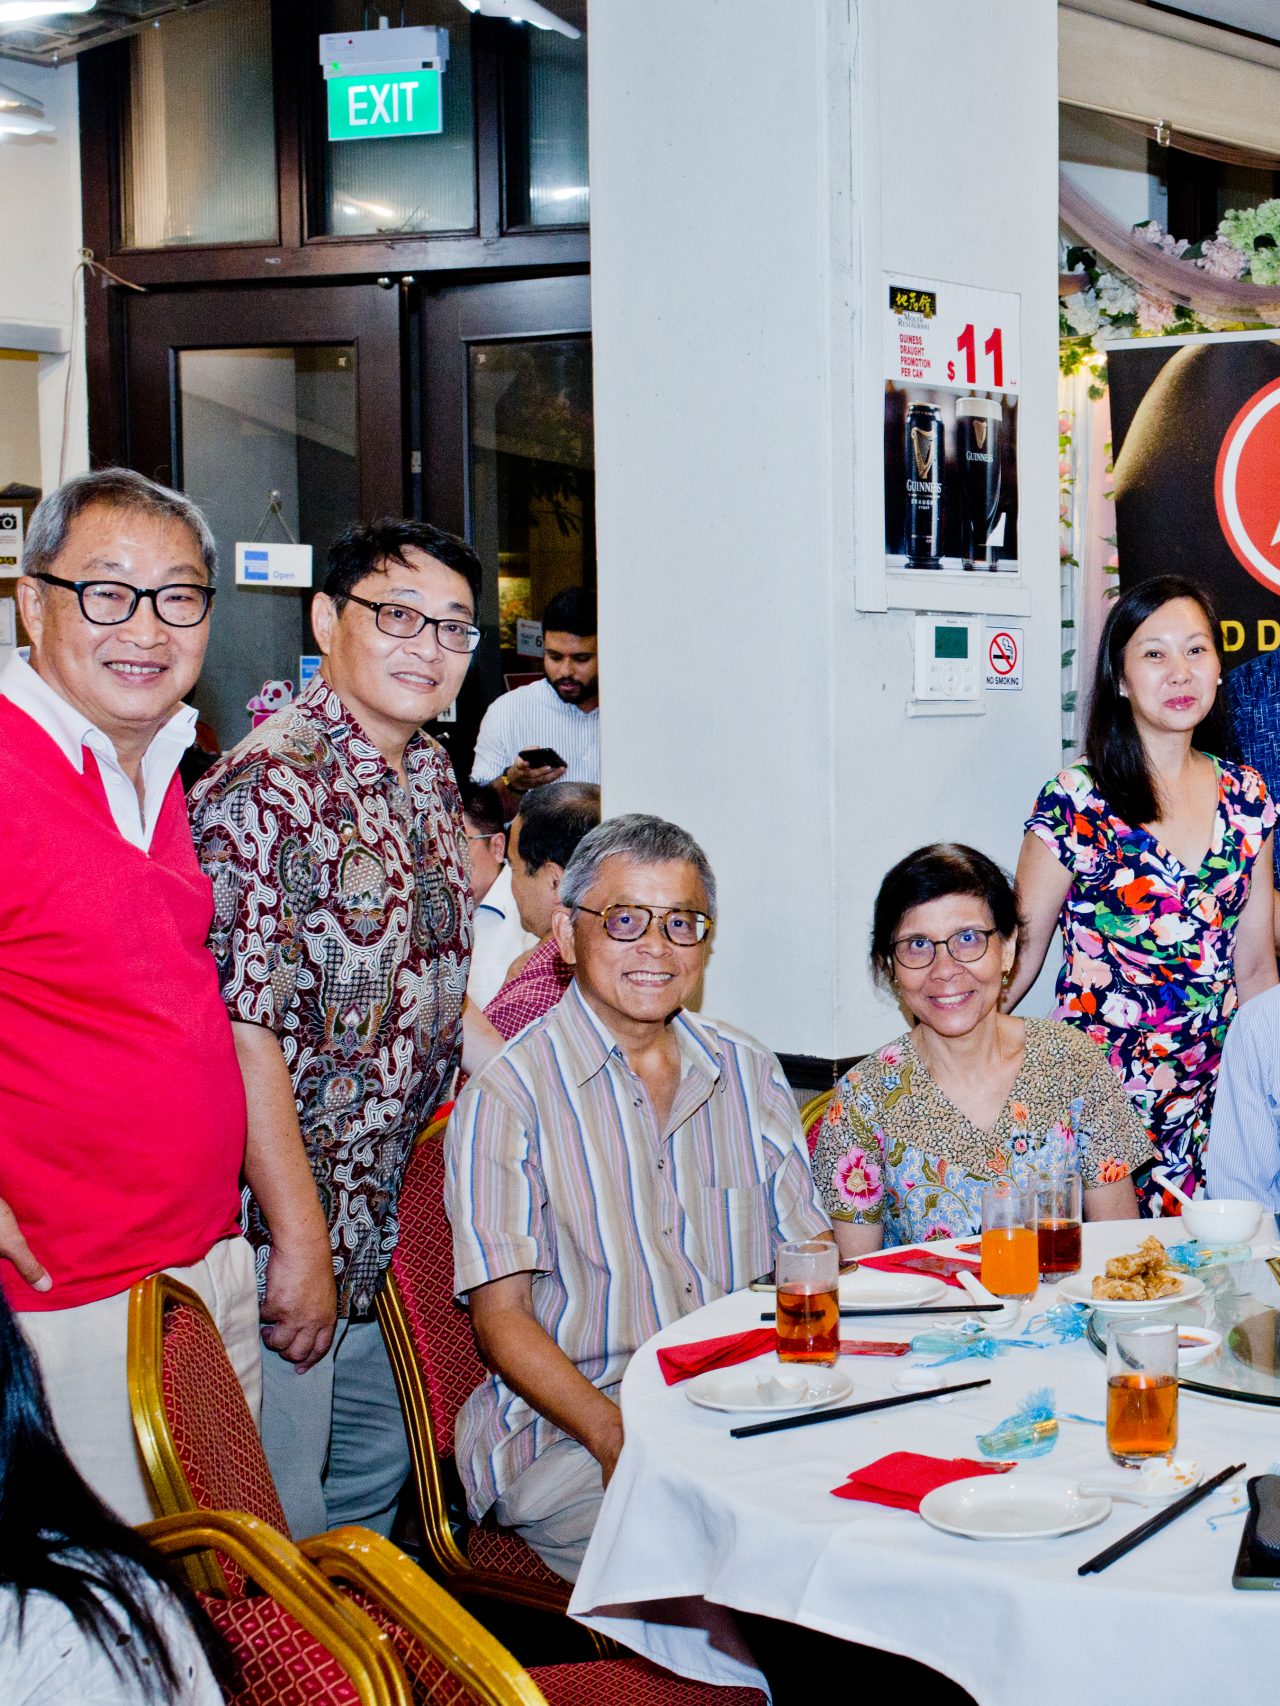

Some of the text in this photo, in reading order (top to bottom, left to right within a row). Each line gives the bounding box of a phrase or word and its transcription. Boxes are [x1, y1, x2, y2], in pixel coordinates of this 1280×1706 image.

[348, 81, 420, 126] EXIT
[900, 334, 922, 345] GUINESS
[900, 345, 924, 356] DRAUGHT
[900, 356, 931, 368] PROMOTION
[901, 367, 923, 379] PER CAN
[966, 450, 993, 463] GUINNESS
[906, 479, 942, 494] GUINNESS
[273, 570, 295, 580] Open
[986, 676, 1020, 686] NO SMOKING
